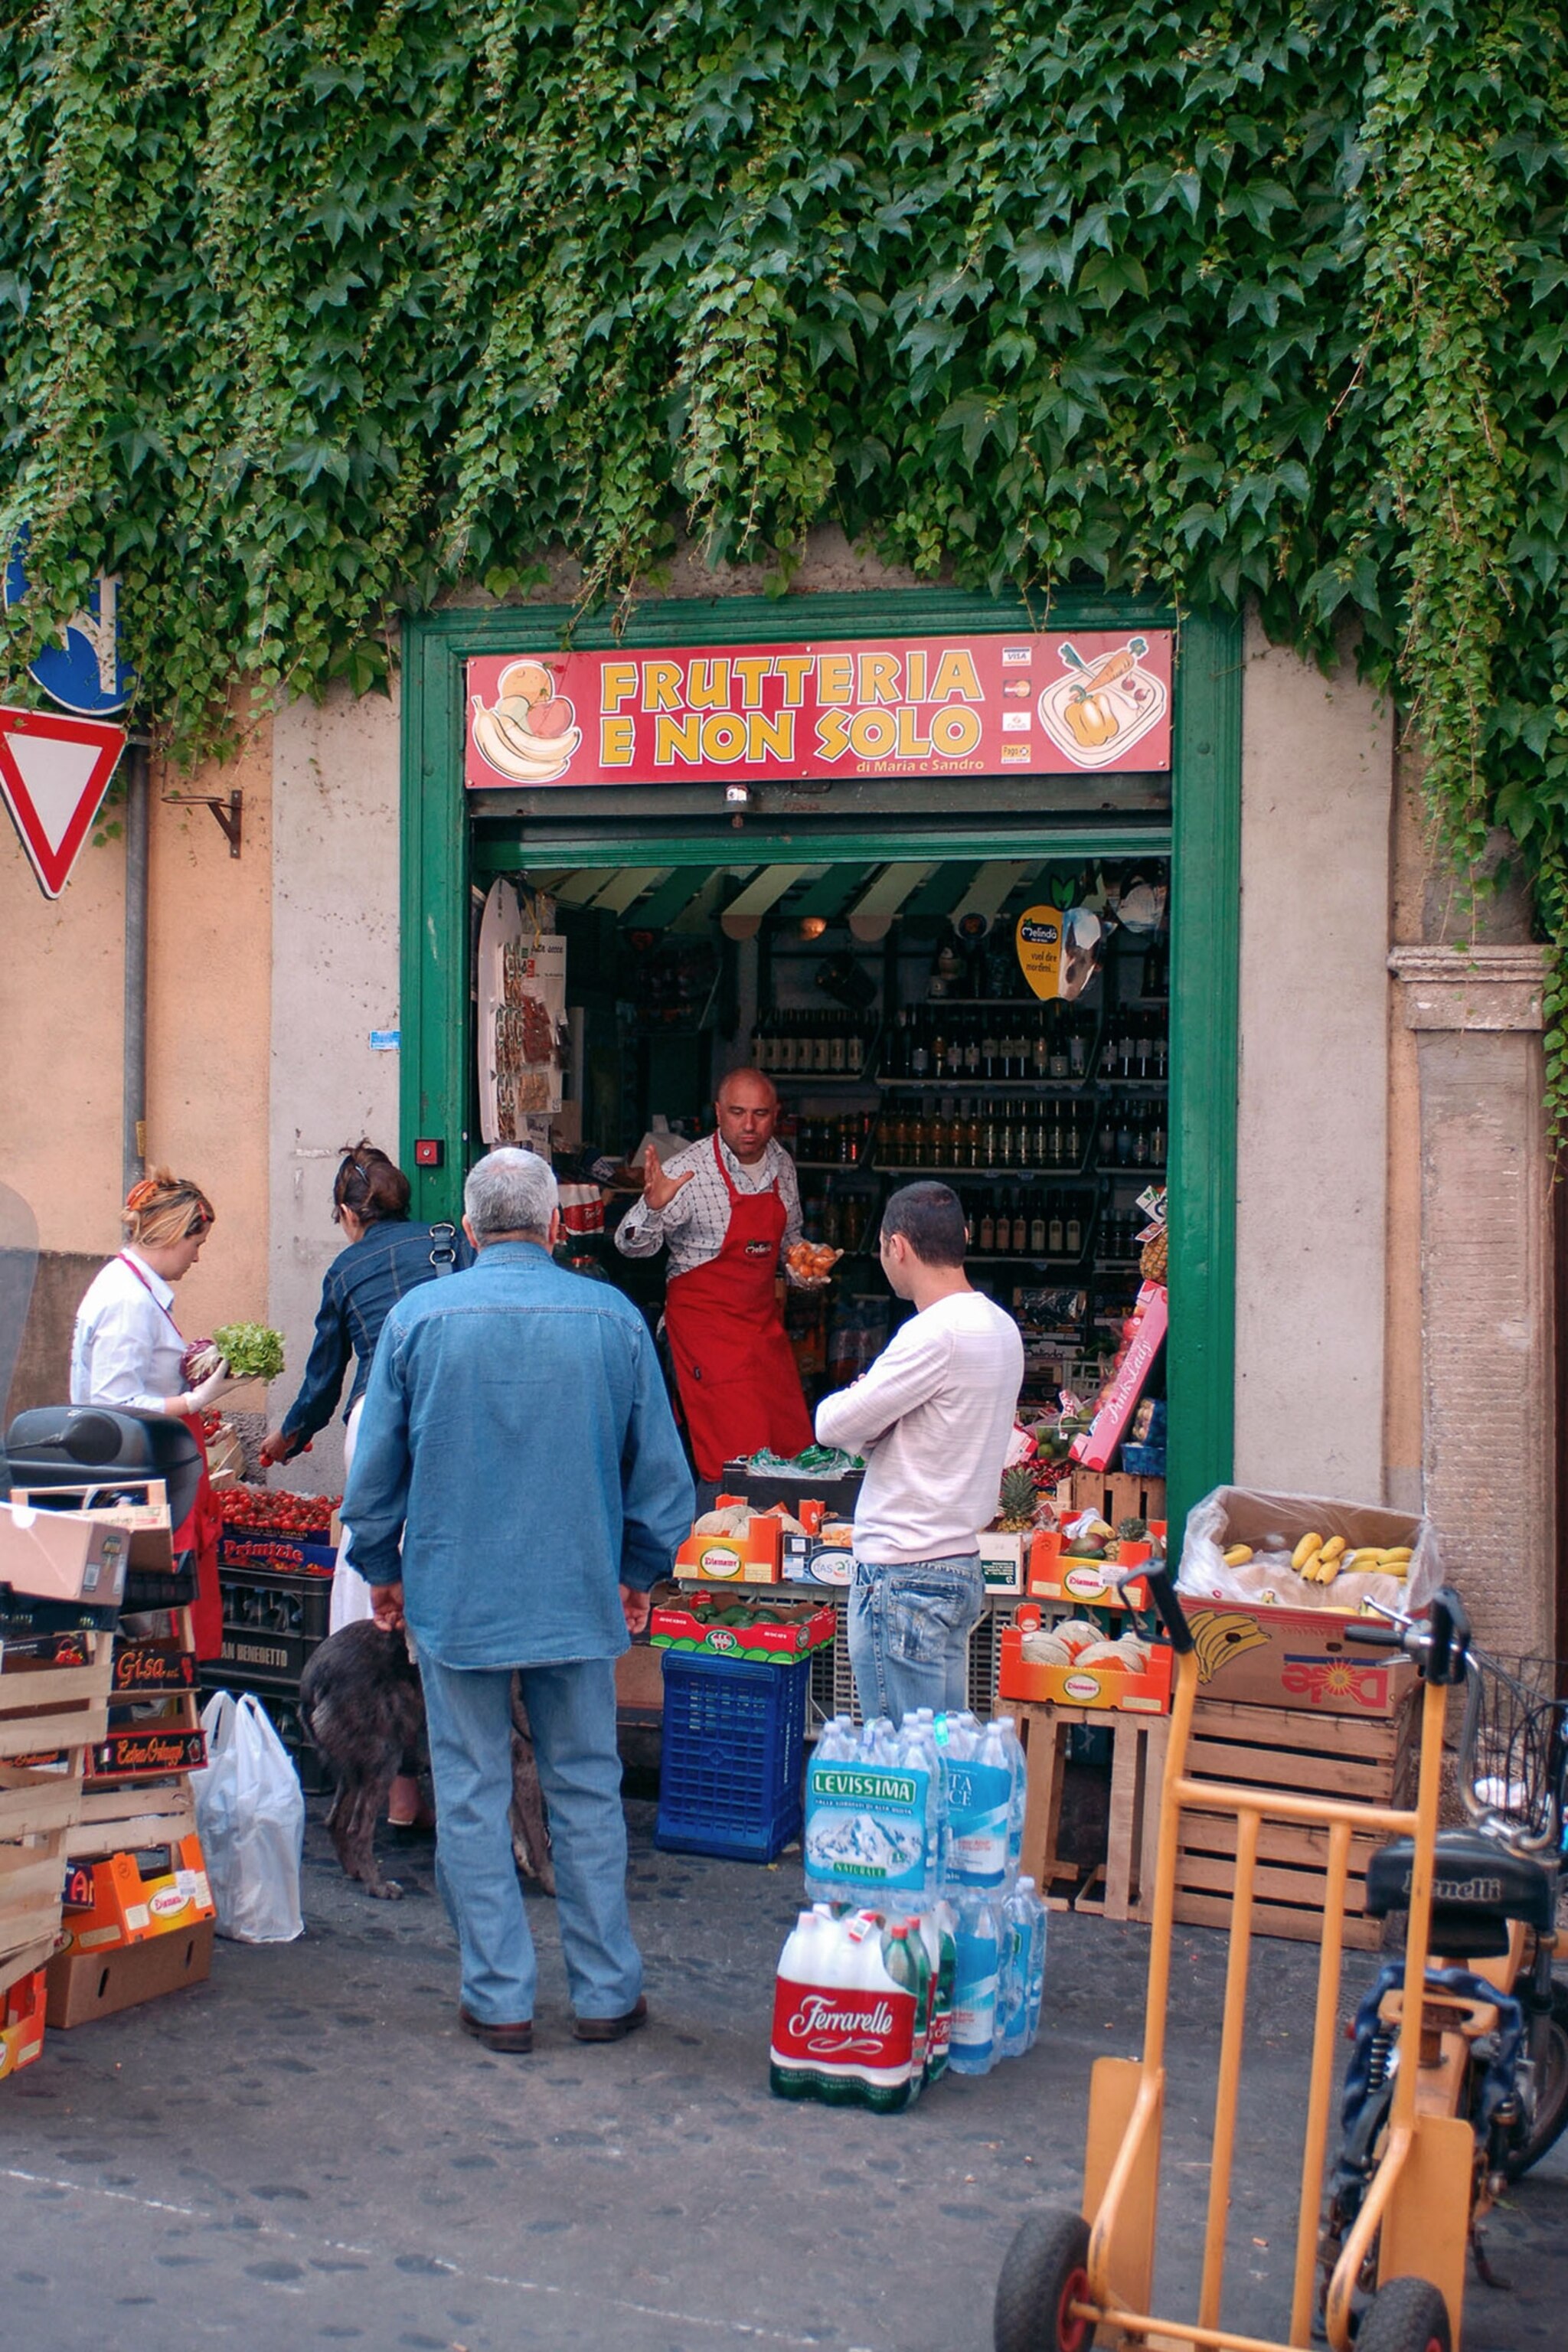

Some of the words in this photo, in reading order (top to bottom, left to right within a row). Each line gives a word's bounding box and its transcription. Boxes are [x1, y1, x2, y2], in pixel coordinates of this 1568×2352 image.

[600, 650, 985, 714] FRUTTERIA
[599, 715, 635, 767] E
[654, 710, 796, 766] NON
[814, 704, 982, 763] SOLO
[856, 760, 870, 773] di
[874, 760, 916, 773] Maria
[920, 762, 928, 771] e
[932, 758, 985, 771] Sandro
[1022, 926, 1057, 939] Melinda
[224, 1540, 304, 1563] Primizie
[117, 1651, 166, 1688] Gisa
[237, 1644, 288, 1668] BENEDETTO
[1281, 1663, 1388, 1709] Dole
[815, 1774, 910, 1802] LEVISSIMA
[789, 1994, 893, 2037] Ferrarelle
